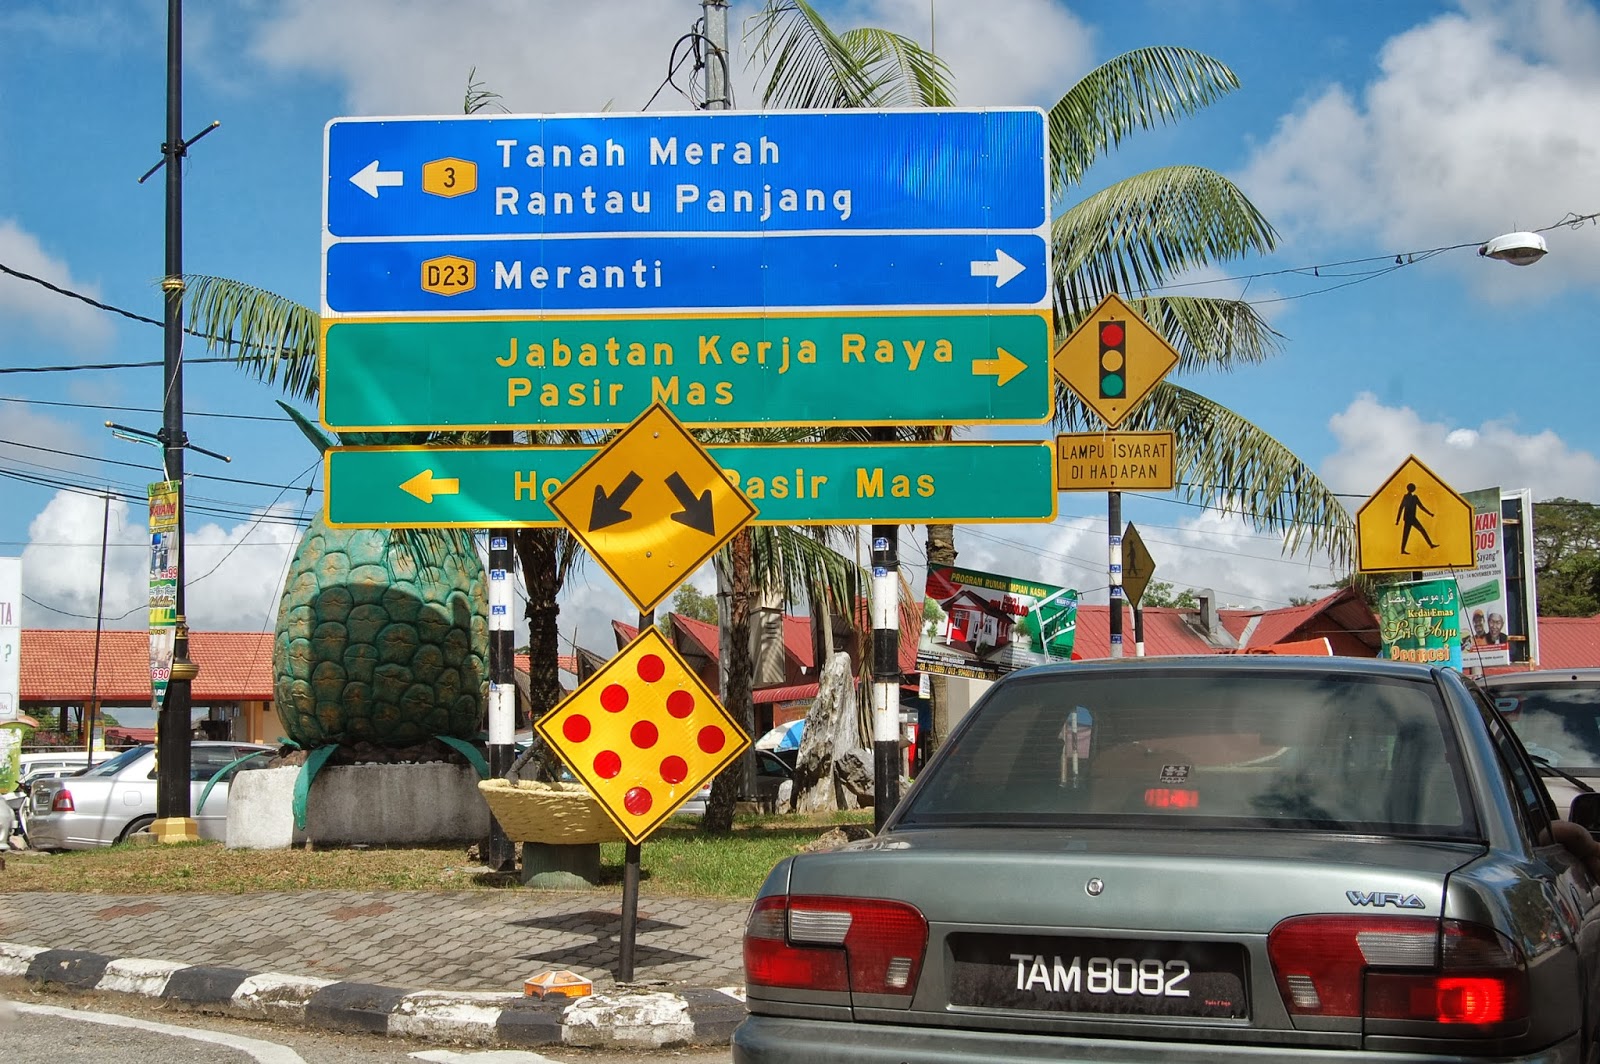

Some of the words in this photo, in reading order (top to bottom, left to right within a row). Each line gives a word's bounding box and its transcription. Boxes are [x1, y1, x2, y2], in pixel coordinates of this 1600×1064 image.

[497, 138, 625, 168] Tanah
[650, 136, 779, 166] Merah
[443, 167, 456, 188] 3
[496, 186, 650, 216] Rantau
[676, 184, 852, 222] Panjang
[428, 265, 469, 286] D23
[494, 259, 662, 290] Meranti
[496, 337, 673, 367] Jabatan
[699, 335, 817, 374] Kerja
[842, 333, 953, 371] Raya
[508, 377, 624, 407] Pasir
[651, 375, 734, 406] Mas
[1062, 444, 1104, 460] LAMPU
[1113, 443, 1168, 459] ISYARAT
[856, 468, 935, 498] Mas
[1071, 465, 1083, 480] DI
[1090, 464, 1157, 479] HADAPAN
[951, 572, 983, 586] PROGRAM
[985, 578, 1007, 591] RUMAH
[1029, 587, 1047, 598] KASIH
[1408, 609, 1430, 618] Kedai
[1431, 608, 1454, 617] Emas
[1384, 620, 1411, 641] Sri
[1346, 891, 1426, 909] WIRA
[1010, 953, 1081, 993] TAM
[1087, 957, 1190, 997] 8082
